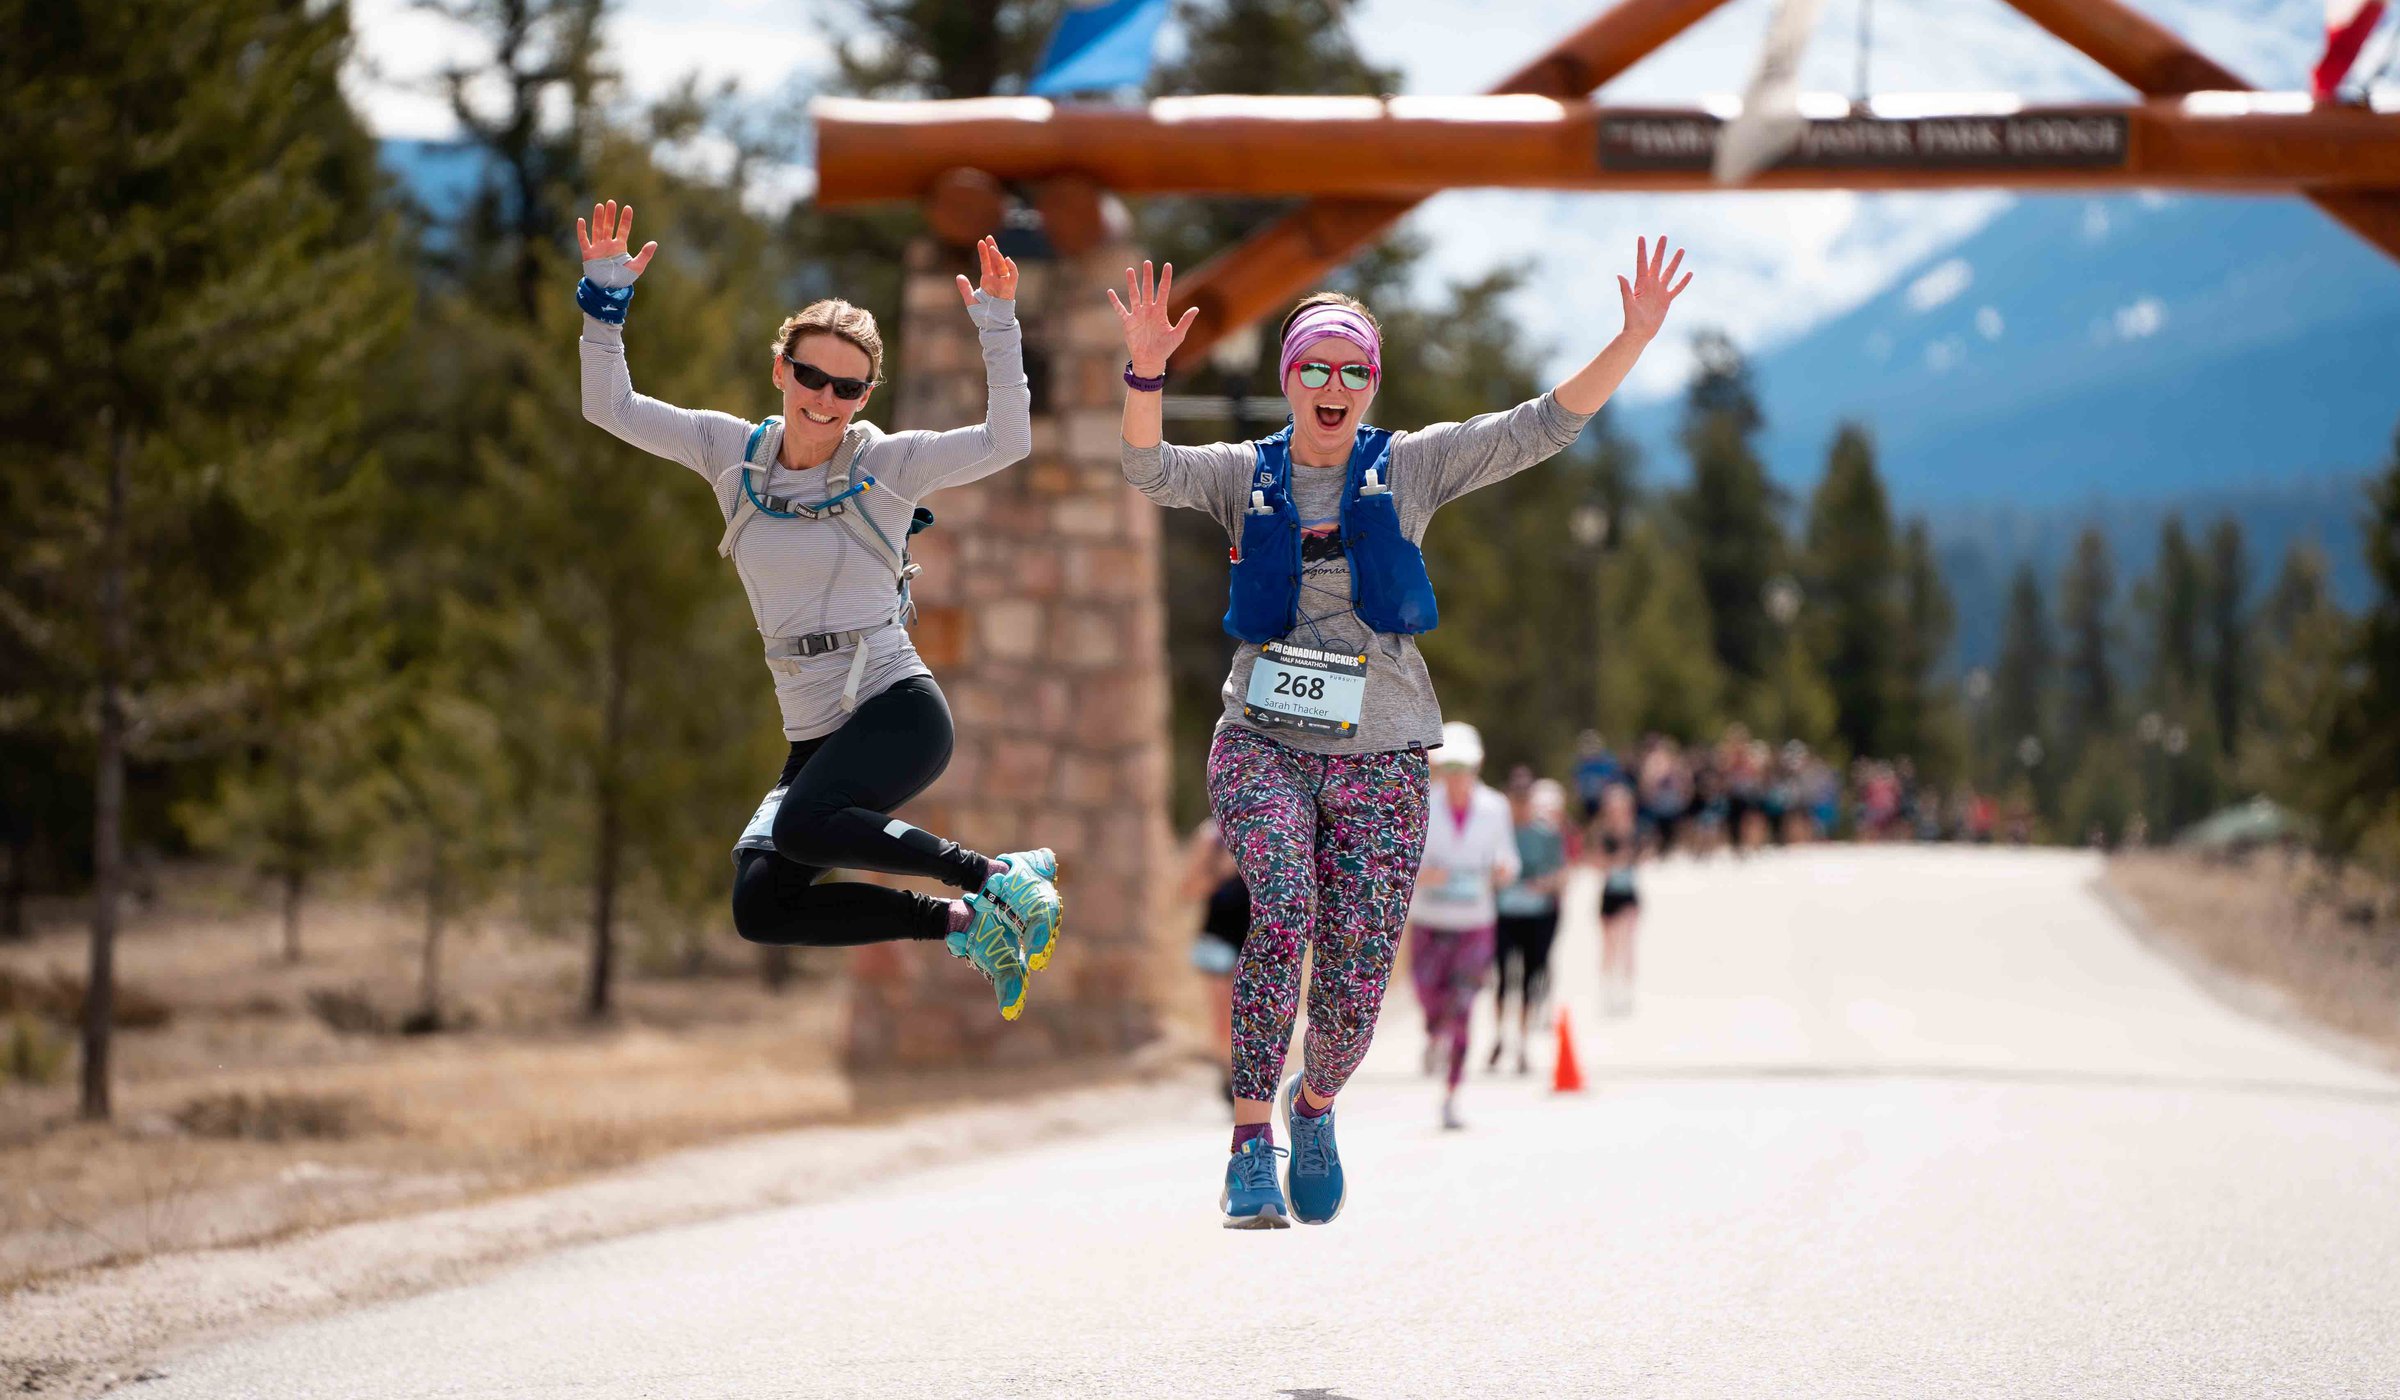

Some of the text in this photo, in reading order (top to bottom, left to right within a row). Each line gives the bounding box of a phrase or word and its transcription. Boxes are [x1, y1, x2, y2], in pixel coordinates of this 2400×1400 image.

[1917, 119, 2001, 154] PARK
[2006, 117, 2118, 153] LODGE
[1302, 564, 1350, 579] agonia
[1280, 656, 1328, 669] HALF MARATHON
[1282, 645, 1323, 660] CANADIAN
[1324, 652, 1359, 666] ROCKIES
[1274, 672, 1325, 700] 268
[1264, 698, 1328, 716] Sarah Thacker
